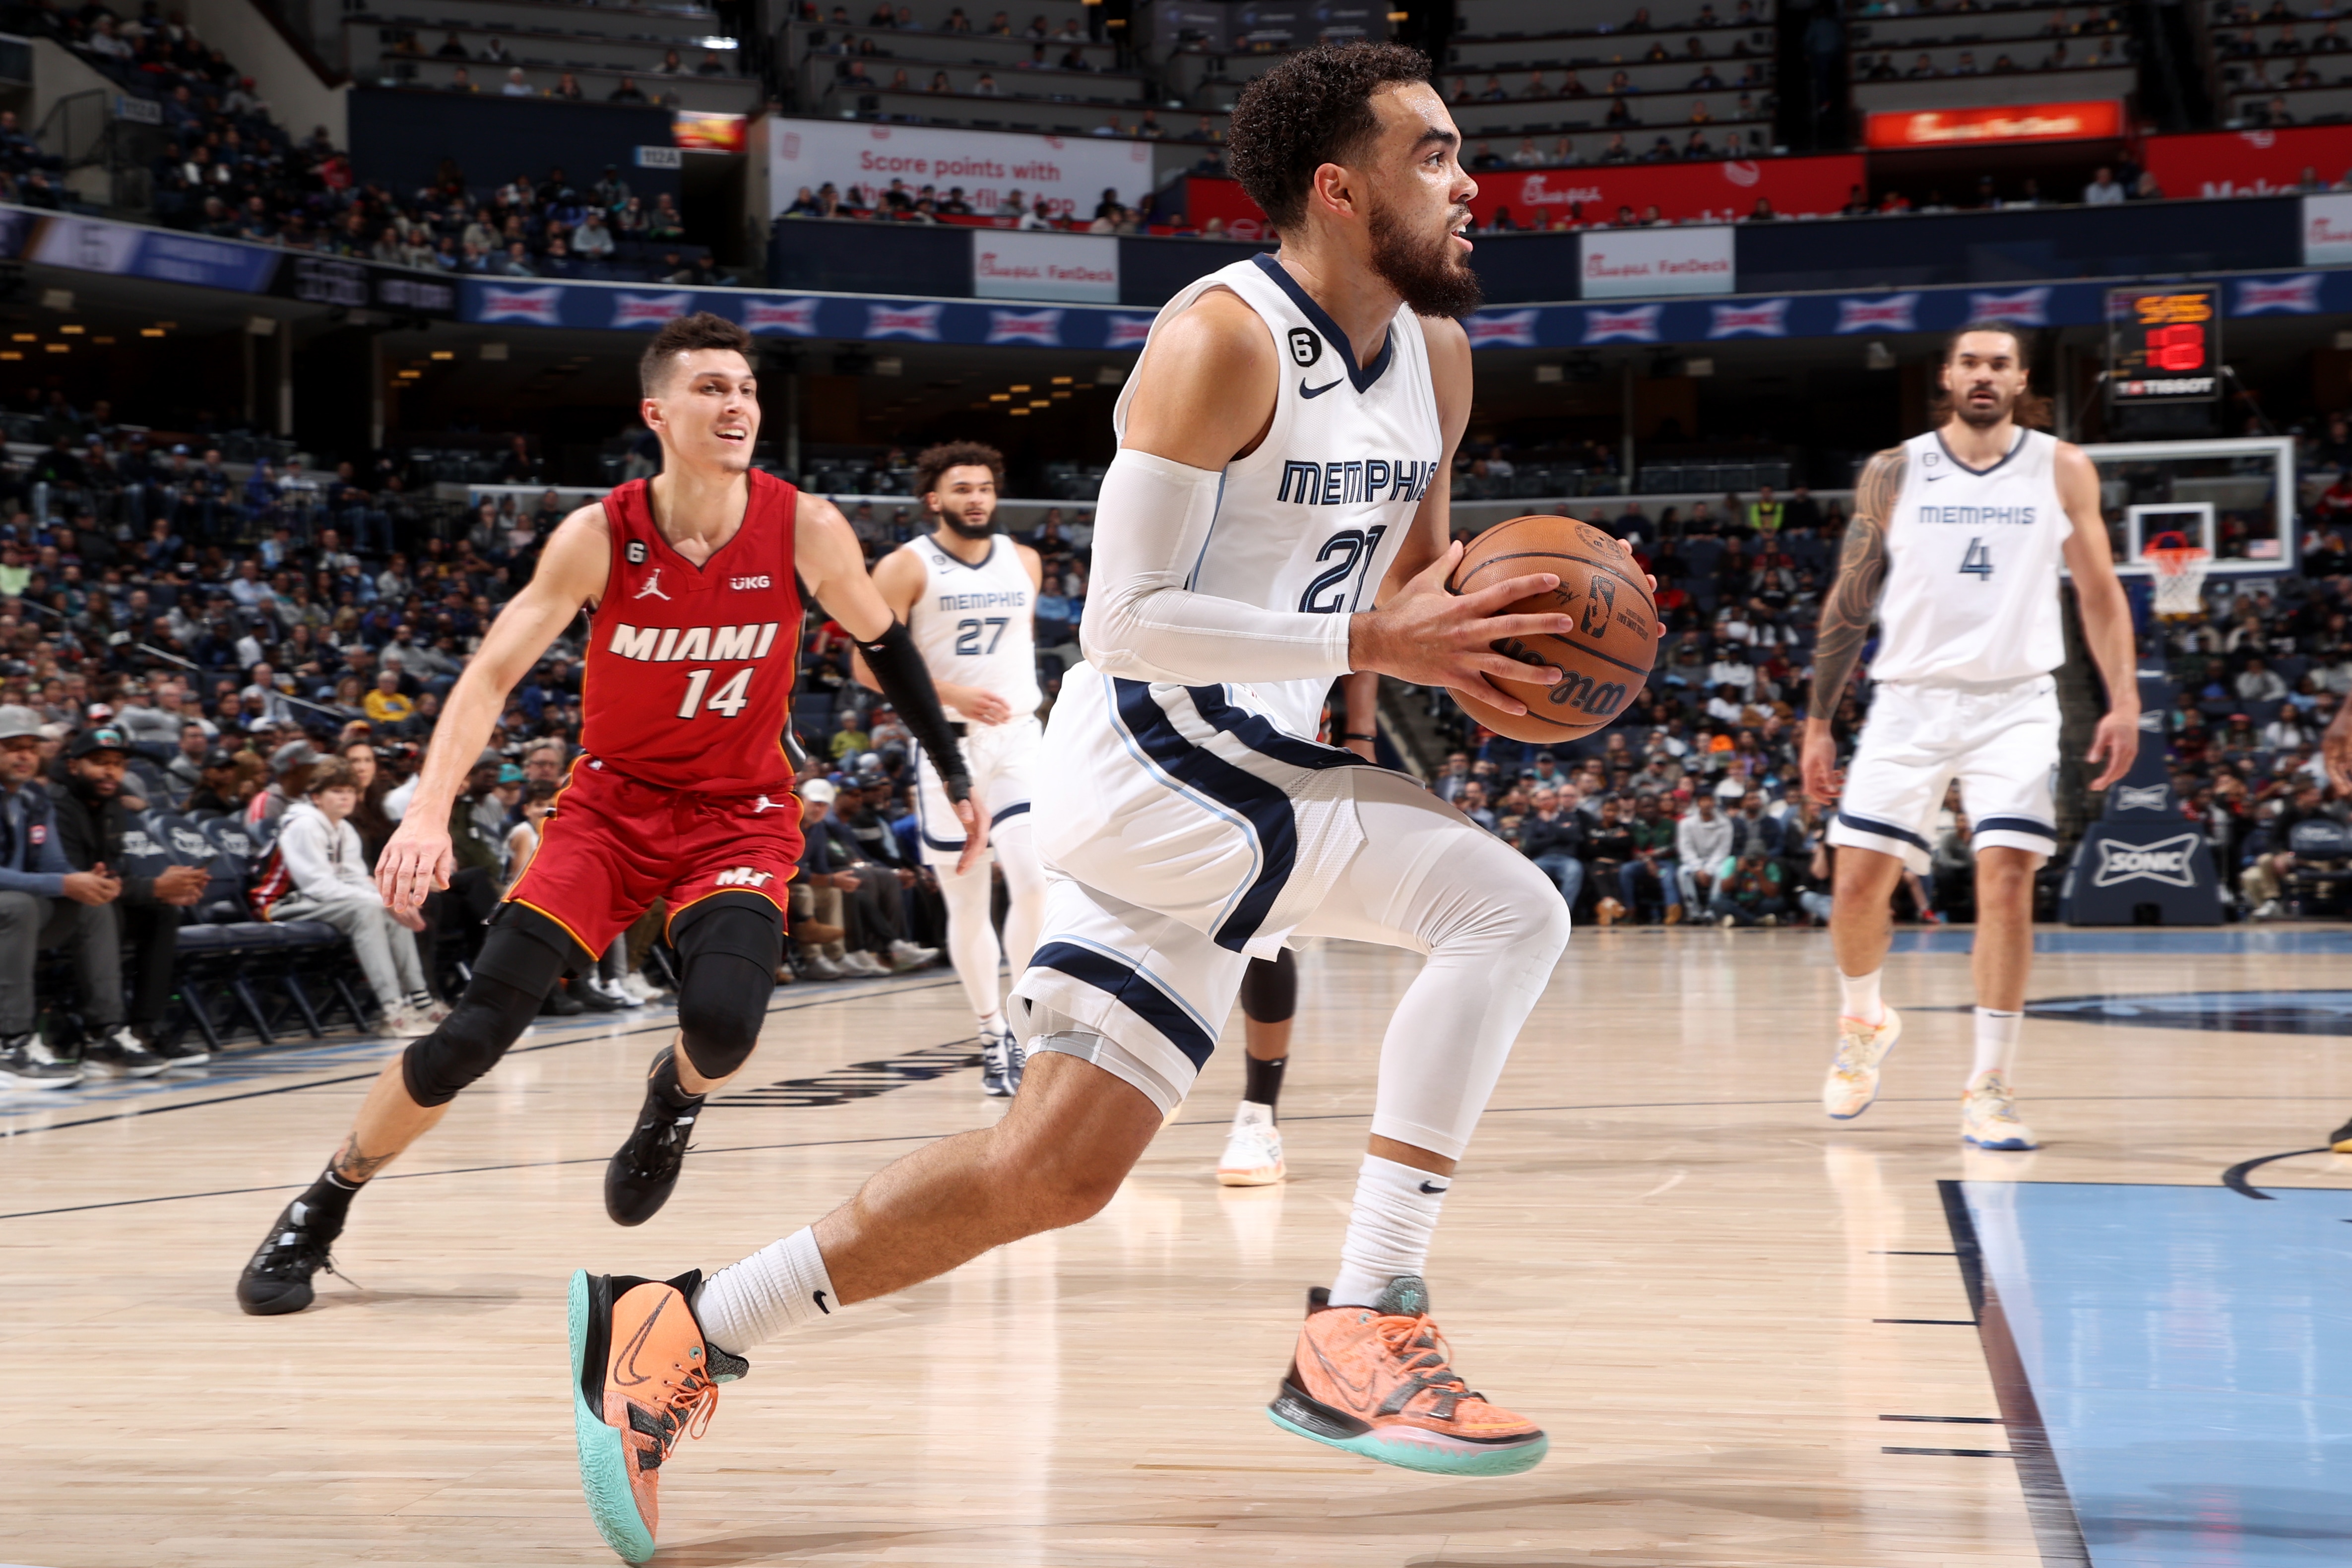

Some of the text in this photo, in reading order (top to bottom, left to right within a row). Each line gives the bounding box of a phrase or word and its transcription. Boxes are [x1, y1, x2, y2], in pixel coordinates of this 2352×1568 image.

[860, 151, 1061, 182] Score points with
[1291, 333, 1313, 362] 6
[2144, 376, 2216, 395] TISSOT
[1919, 505, 2036, 524] MEMPHIS
[628, 542, 646, 563] 6
[1958, 537, 1994, 581] 4
[1298, 525, 1388, 613] 21
[940, 591, 1025, 611] MEMPHIS
[607, 622, 779, 663] MIAMI
[955, 617, 1011, 655] 27
[677, 666, 756, 719] 14
[2108, 851, 2184, 872] SONIC
